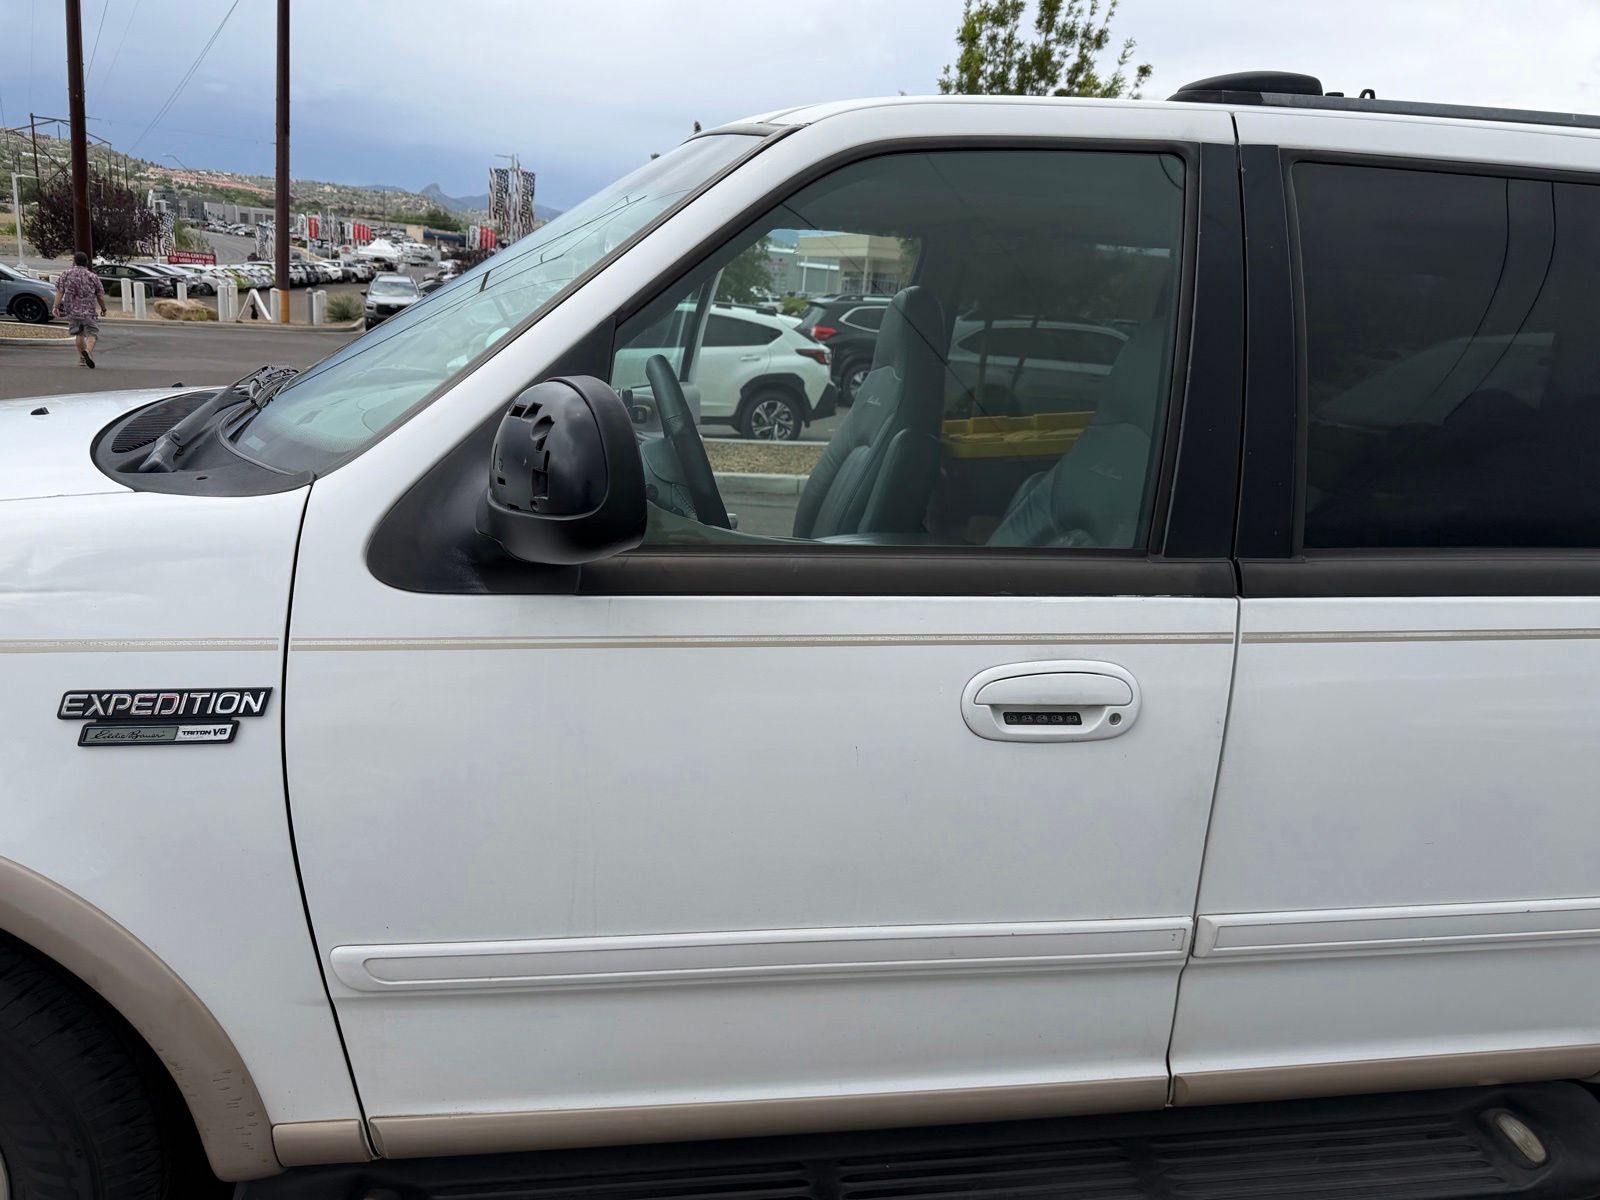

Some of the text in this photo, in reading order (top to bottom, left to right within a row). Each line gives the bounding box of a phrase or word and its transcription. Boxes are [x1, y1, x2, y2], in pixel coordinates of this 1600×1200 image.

[60, 691, 266, 716] EXPEDITION
[91, 728, 165, 740] Eddie Bauer
[212, 728, 227, 737] V8
